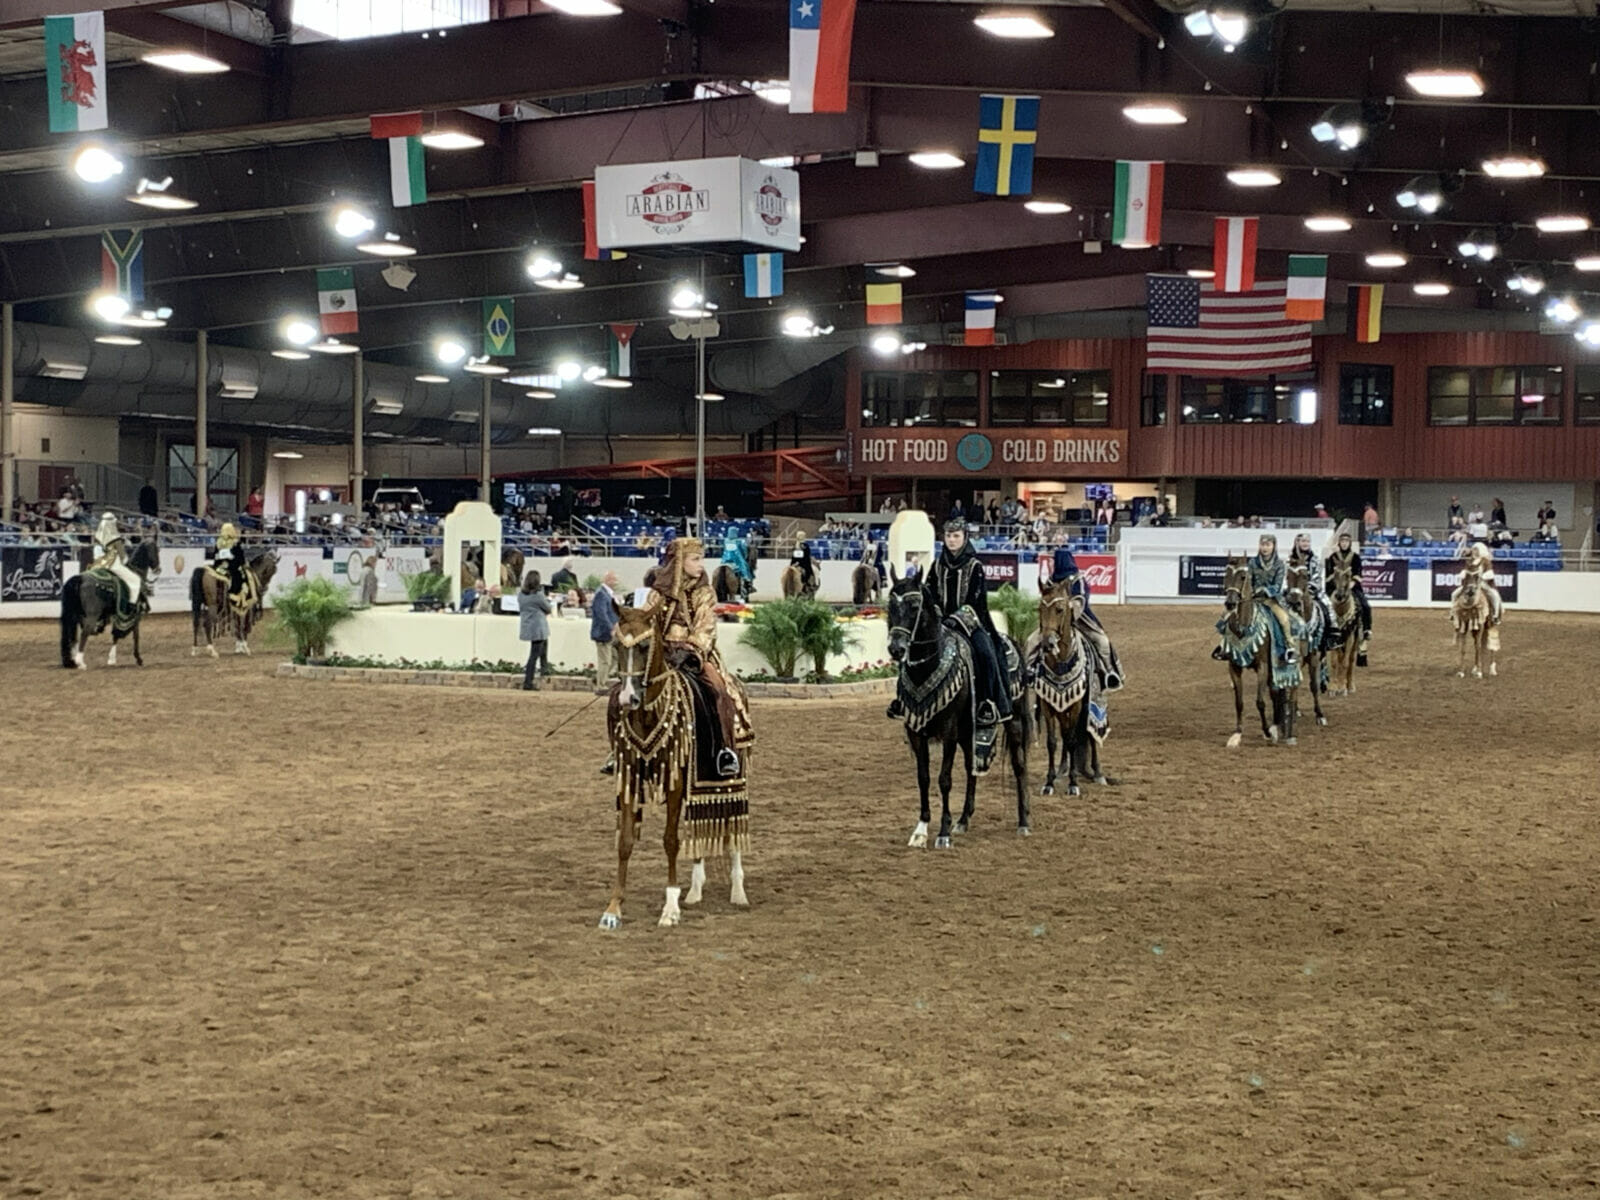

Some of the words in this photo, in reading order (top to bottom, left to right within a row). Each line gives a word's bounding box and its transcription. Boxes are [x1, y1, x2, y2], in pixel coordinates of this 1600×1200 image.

[632, 191, 704, 215] ARABIAN
[862, 438, 897, 462] HOT
[904, 438, 948, 462] FOOD
[1002, 438, 1047, 463] COLD
[1053, 439, 1120, 464] DRINKS
